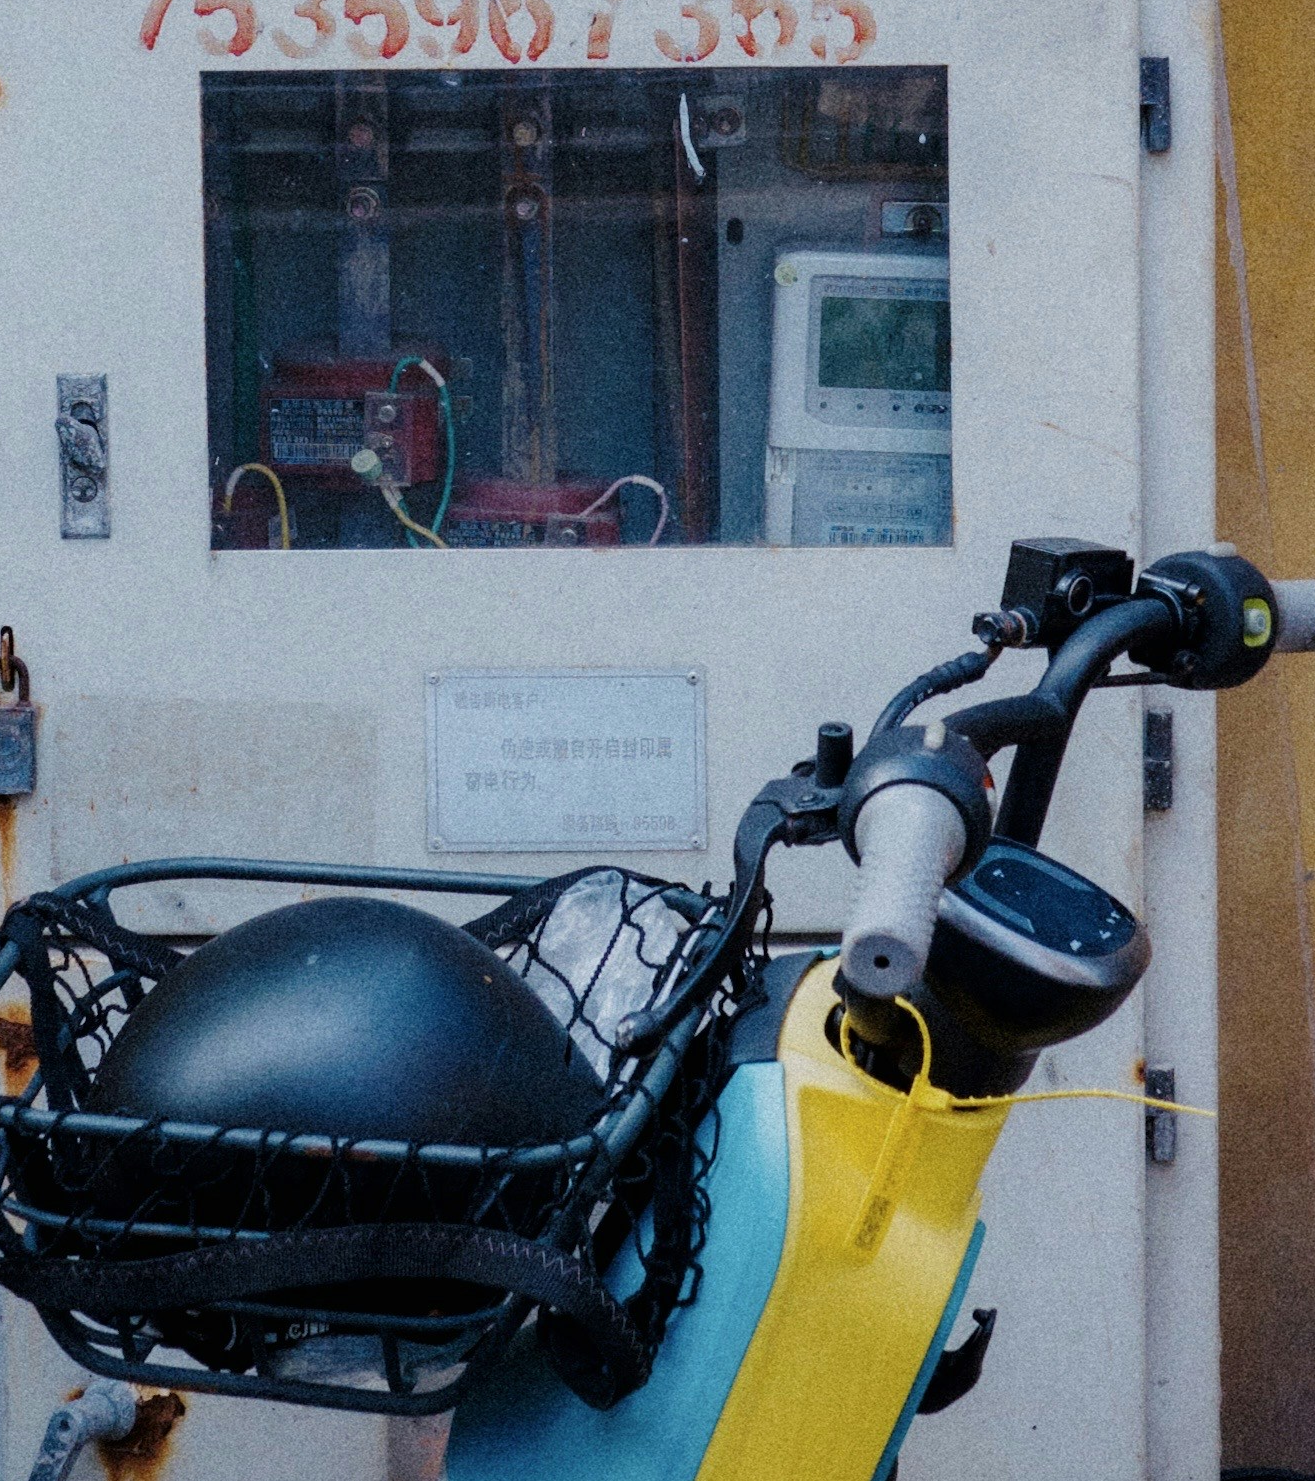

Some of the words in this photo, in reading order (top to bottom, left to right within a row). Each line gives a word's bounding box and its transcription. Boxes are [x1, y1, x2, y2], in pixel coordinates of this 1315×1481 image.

[500, 737, 672, 760] 伪造或擅自开启封印属
